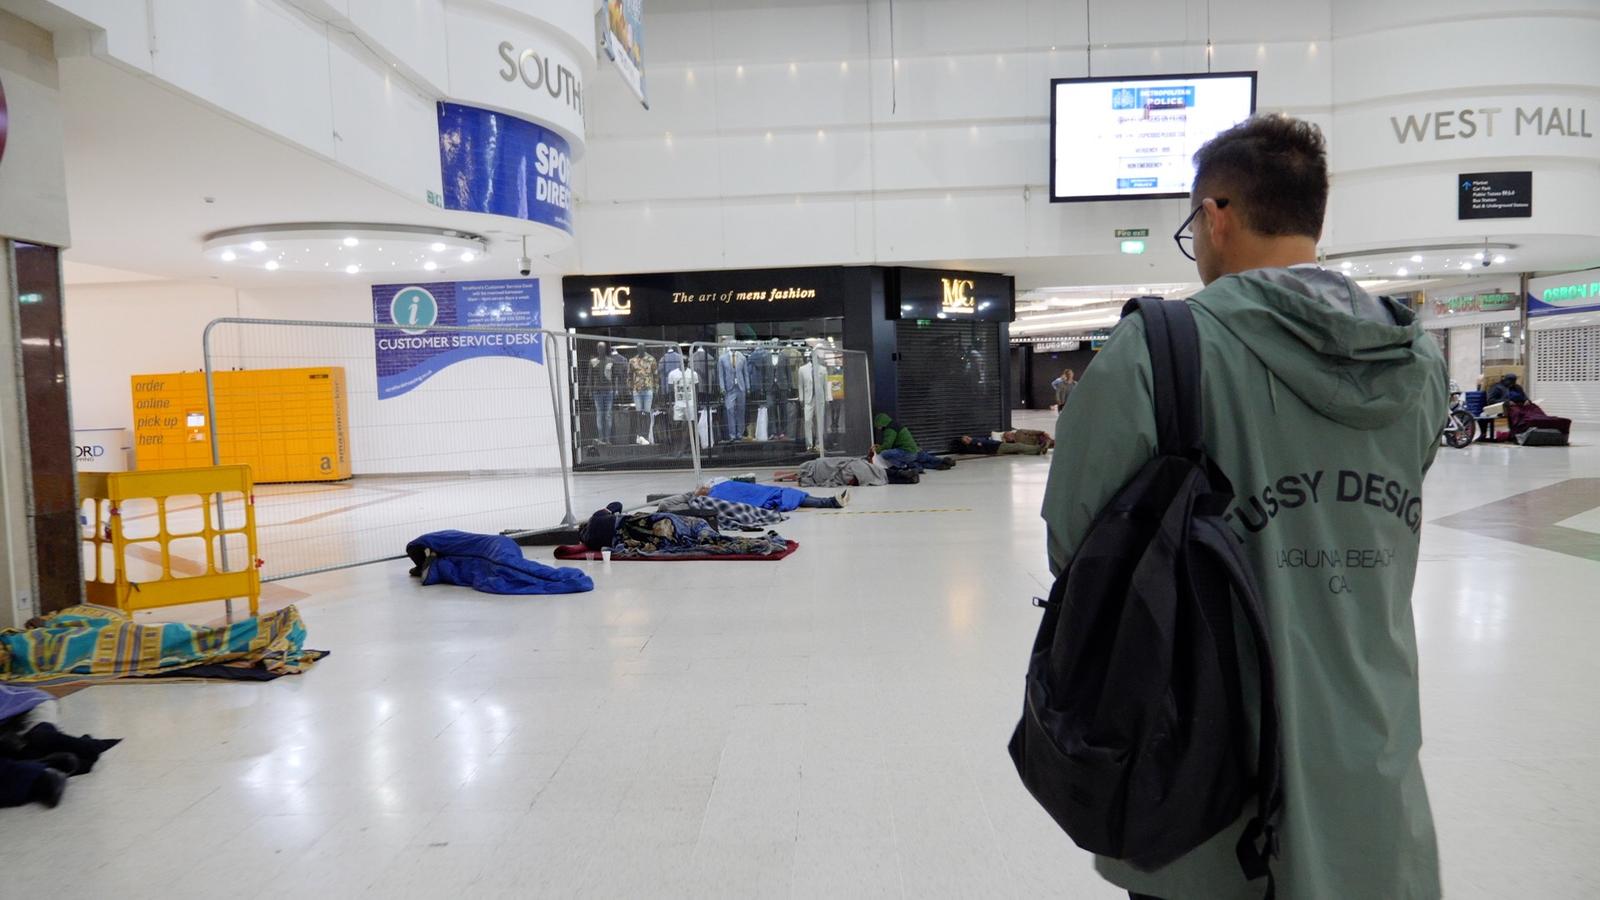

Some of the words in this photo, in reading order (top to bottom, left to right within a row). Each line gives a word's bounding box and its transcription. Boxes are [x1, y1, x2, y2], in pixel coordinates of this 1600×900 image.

[498, 41, 582, 115] SOUTH
[1140, 89, 1191, 97] METROPOLITAN
[1147, 97, 1184, 105] POLICE
[1390, 108, 1502, 144] WEST
[1516, 106, 1593, 138] MALL
[590, 286, 631, 310] MC
[672, 292, 694, 303] The
[698, 292, 716, 302] art
[720, 290, 734, 303] of
[736, 290, 767, 301] mens
[768, 288, 816, 302] fashion
[941, 278, 975, 307] MC
[378, 337, 450, 350] CUSTOMER
[451, 334, 503, 348] SERVICE
[505, 333, 538, 346] DESK
[136, 380, 164, 392] order
[136, 399, 170, 409] online
[137, 415, 161, 430] pick
[163, 416, 178, 429] up
[138, 433, 163, 446] here
[1276, 548, 1342, 568] LAGUNA
